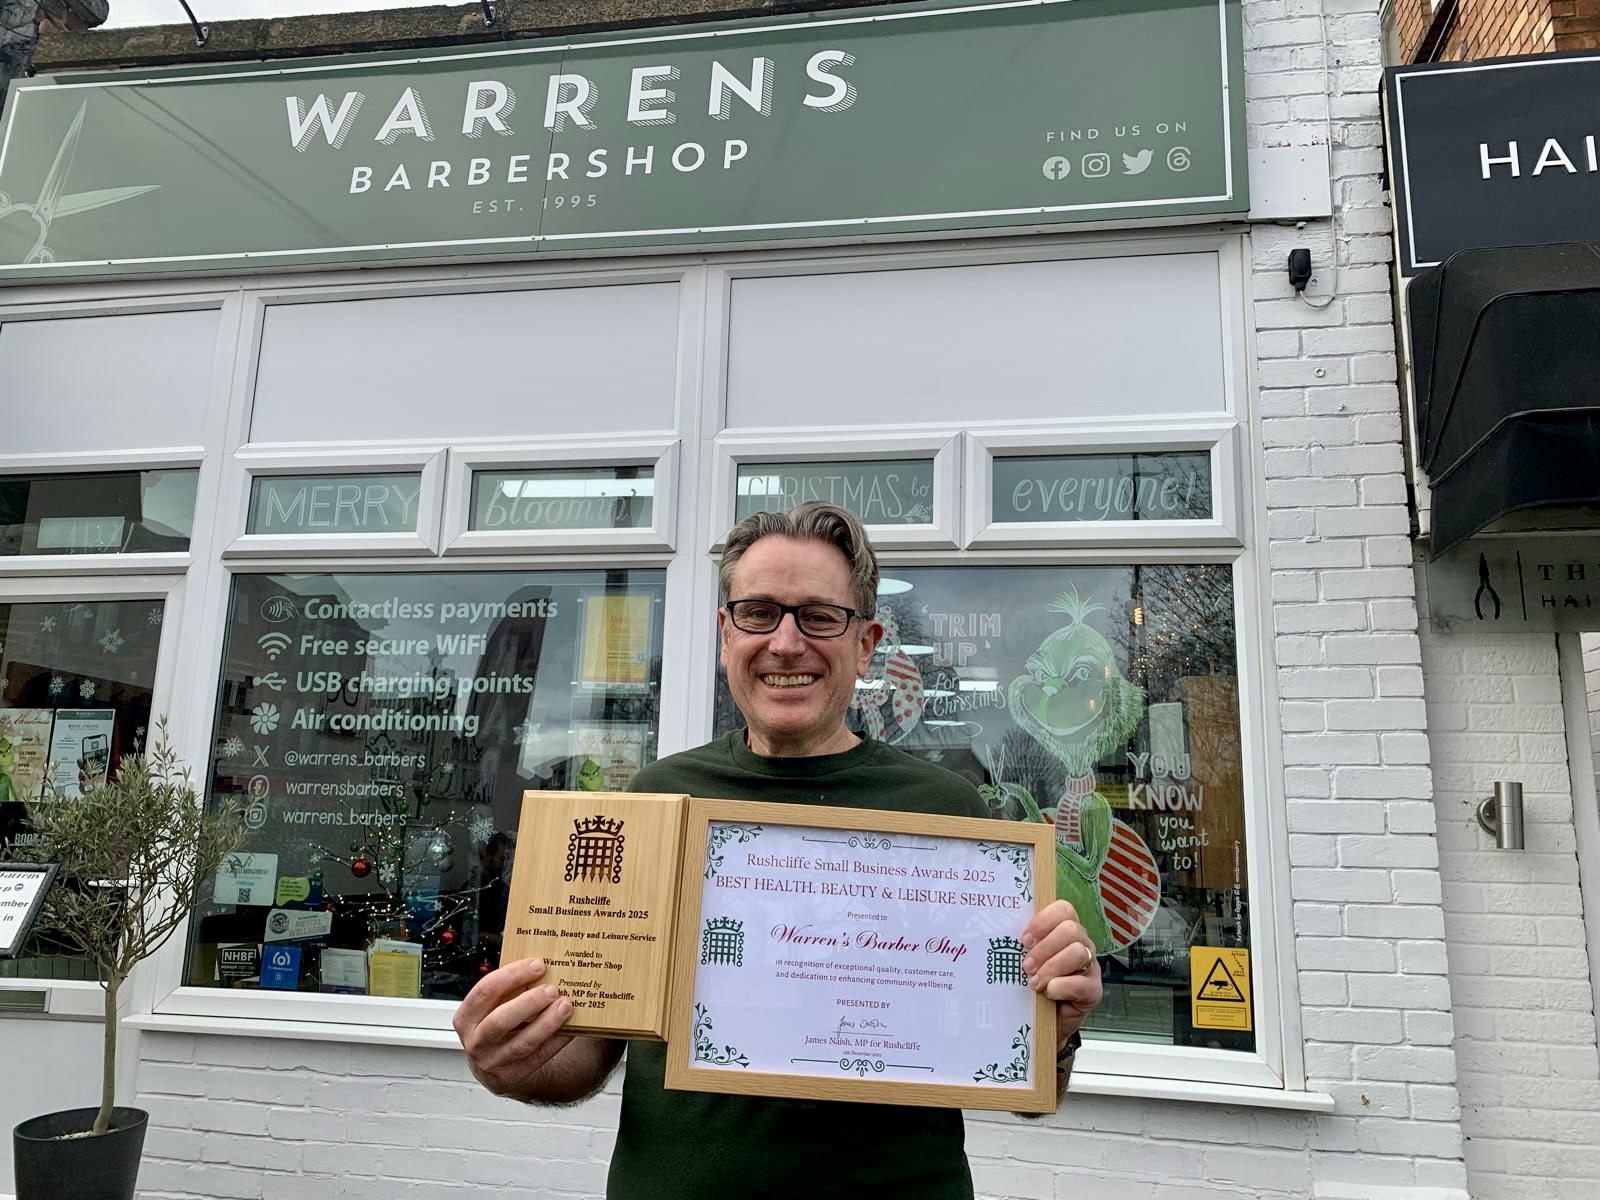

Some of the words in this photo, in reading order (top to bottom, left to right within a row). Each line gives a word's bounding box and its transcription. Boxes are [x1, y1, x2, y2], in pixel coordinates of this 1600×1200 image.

[285, 49, 857, 152] WARRENS
[1046, 127, 1101, 143] FIND
[1114, 124, 1142, 139] US
[1156, 121, 1189, 135] ON
[349, 138, 749, 195] BARBERSHOP
[1479, 135, 1598, 180] HAI
[472, 200, 523, 214] EST.
[541, 193, 599, 210] 1995
[265, 484, 421, 527] MERRY
[746, 472, 903, 519] CHRISTMAS
[911, 473, 931, 498] to
[1012, 470, 1197, 521] everyone!
[1537, 563, 1600, 581] TH
[304, 598, 434, 620] Contactless
[440, 600, 559, 624] payments
[300, 635, 347, 656] Free
[355, 639, 429, 656] secure
[436, 634, 487, 656] WiFi
[296, 671, 341, 693] USB
[347, 671, 452, 699] charging
[458, 672, 534, 695] points
[932, 672, 959, 697] for
[291, 707, 326, 730] Air
[329, 707, 480, 737] conditioning
[284, 750, 426, 768] @warrens_barbers
[1126, 751, 1191, 780] YOU
[286, 780, 405, 798] warrensbarbers
[1128, 783, 1204, 811] KNOW
[282, 808, 408, 827] warrens_barbers
[1158, 816, 1195, 839] you
[1161, 828, 1210, 851] want
[747, 853, 811, 870] Rushcliffe
[814, 858, 848, 873] Small
[854, 861, 907, 877] Business
[911, 865, 959, 880] Awards
[963, 869, 996, 883] 2025
[1172, 851, 1198, 871] to!
[569, 894, 611, 906] Rushcliffe
[716, 875, 750, 889] BEST
[821, 882, 877, 898] BEAUTY
[882, 886, 893, 899] &
[898, 887, 956, 905] LEISURE
[960, 892, 1021, 909] SERVICE
[0, 900, 29, 908] mber
[529, 905, 553, 915] Small
[555, 907, 592, 917] Business
[594, 908, 626, 918] Awards
[628, 910, 649, 920] 2025
[847, 911, 880, 920] Presented
[533, 928, 559, 938] Health,
[560, 930, 585, 940] Beauty
[586, 931, 600, 939] and
[602, 932, 629, 941] Leisure
[629, 933, 657, 942] Service
[770, 923, 850, 947] Warren's
[854, 930, 920, 952] Barber
[924, 935, 967, 962] Shop
[224, 951, 254, 961] NHBF
[564, 950, 594, 958] Awarded
[543, 958, 576, 967] Warren's
[577, 959, 602, 968] Barber
[604, 961, 623, 971] Shop
[784, 960, 824, 969] recognition
[825, 961, 834, 969] of
[834, 963, 875, 973] exceptional
[876, 965, 903, 975] quality,
[904, 968, 938, 976] customer
[558, 979, 593, 988] Presented
[593, 981, 602, 990] by
[791, 972, 828, 981] dedication
[838, 975, 875, 985] enhancing
[876, 978, 916, 988] community
[917, 980, 955, 990] wellbeing.
[586, 990, 597, 998] for
[599, 991, 635, 1000] Rushcliffe
[836, 999, 879, 1008] PRESENTED
[588, 1001, 606, 1009] 2025
[804, 1035, 828, 1045] James
[854, 1038, 868, 1047] MP
[870, 1039, 881, 1048] for
[883, 1041, 921, 1051] Rushcliffe
